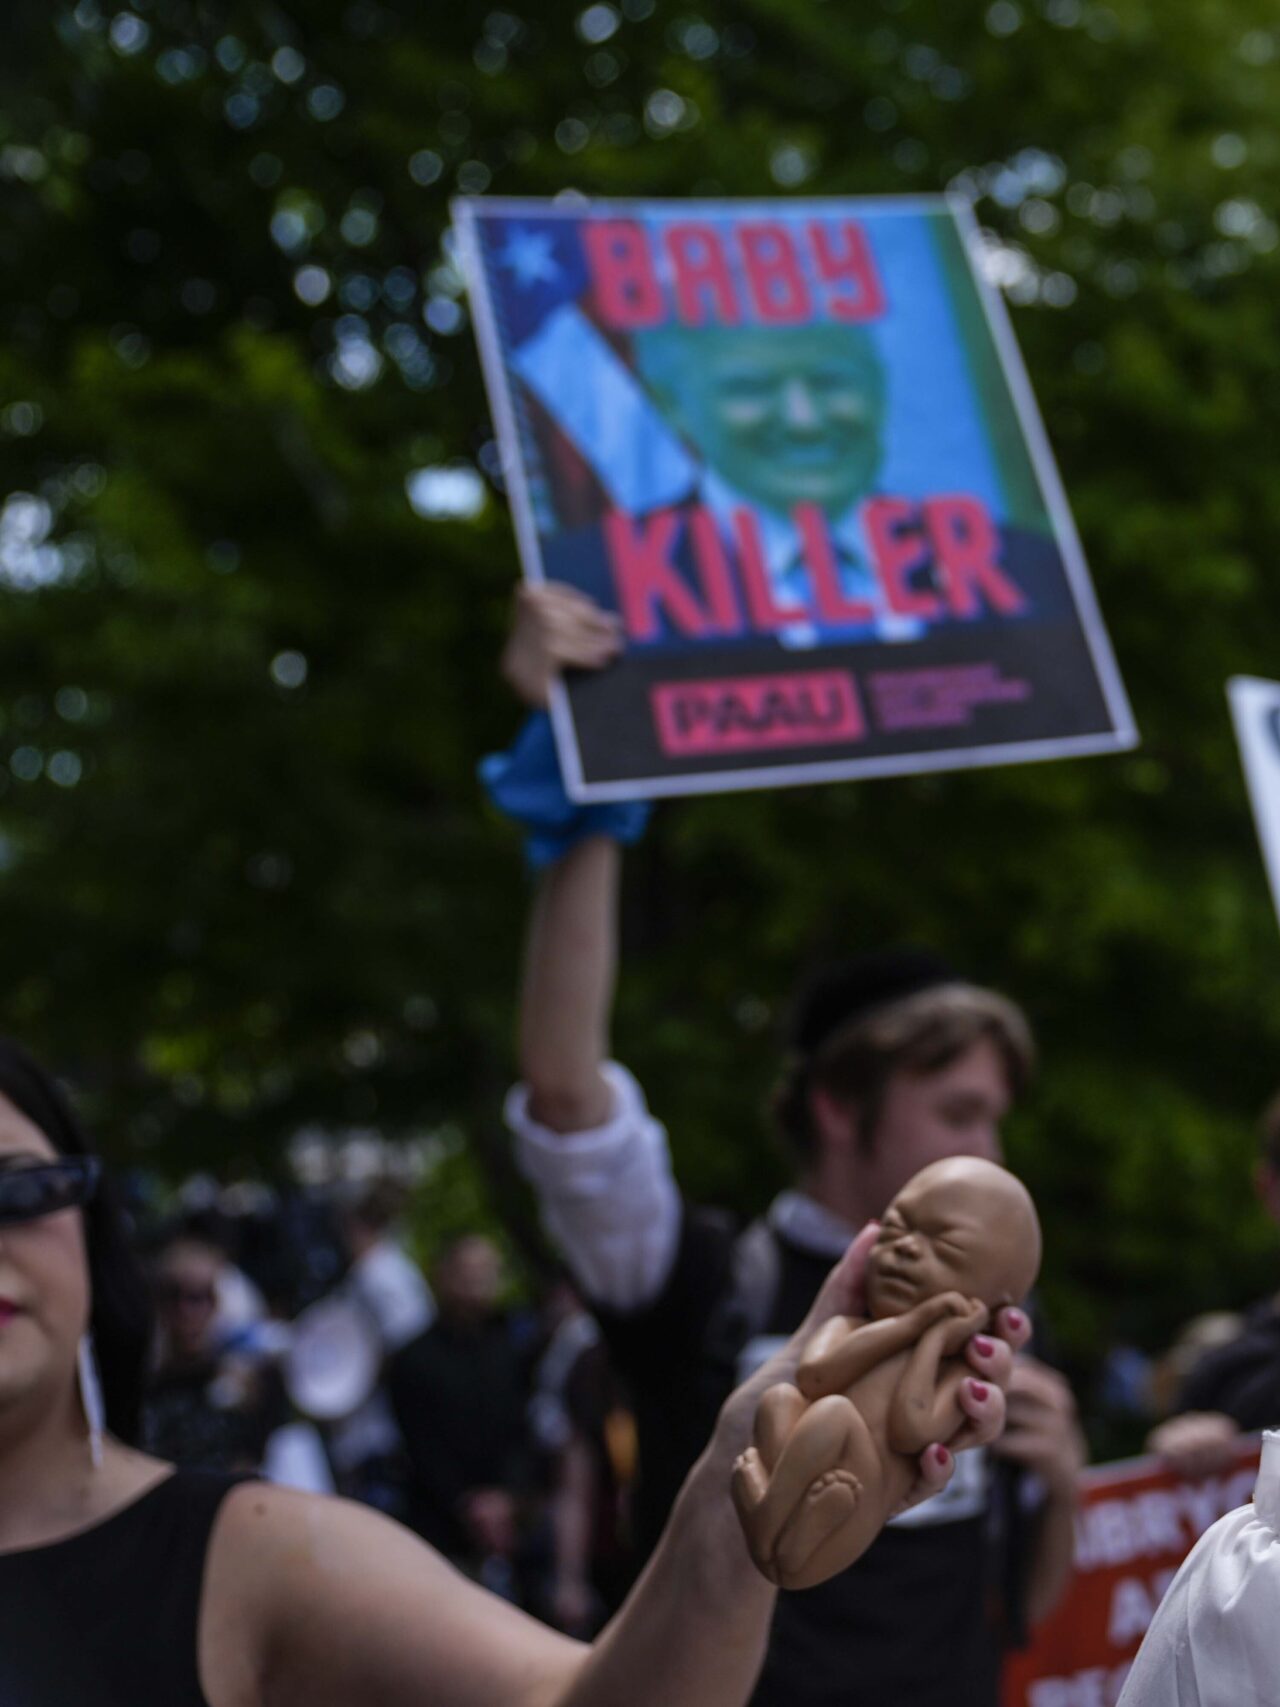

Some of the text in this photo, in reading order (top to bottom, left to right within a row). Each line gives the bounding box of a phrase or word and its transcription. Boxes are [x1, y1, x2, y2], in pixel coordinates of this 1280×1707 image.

[584, 217, 888, 328] BABY
[607, 494, 1026, 640] KILLER
[674, 687, 848, 740] PAAU
